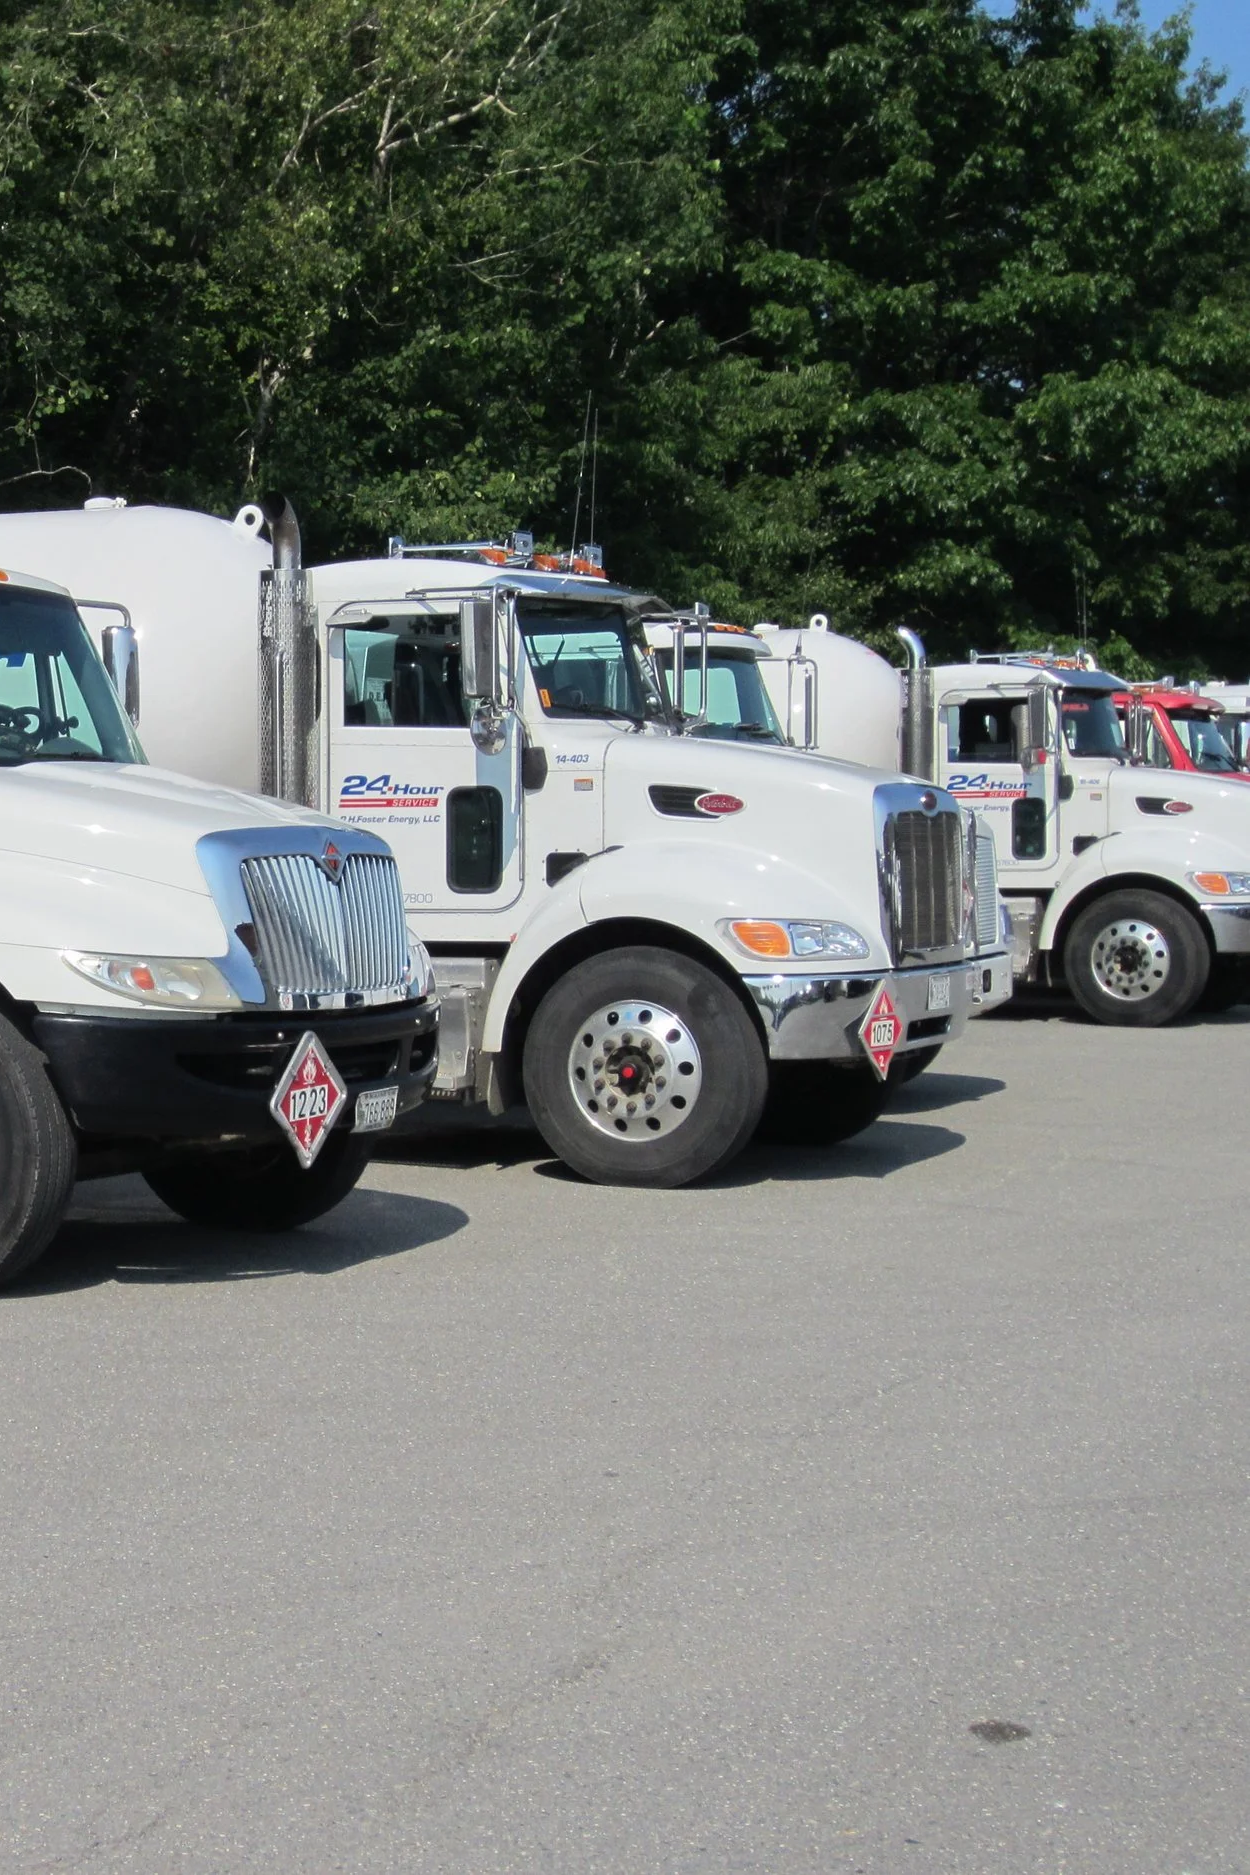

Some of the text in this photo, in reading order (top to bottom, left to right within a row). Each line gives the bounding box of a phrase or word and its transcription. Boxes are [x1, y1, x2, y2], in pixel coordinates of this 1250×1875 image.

[555, 754, 589, 764] 14-403
[391, 799, 436, 808] SERVICE
[388, 815, 421, 825] Energy,
[423, 815, 441, 823] LLC
[873, 1024, 893, 1043] 1075
[879, 1055, 885, 1067] 2
[292, 1087, 326, 1119] 1223
